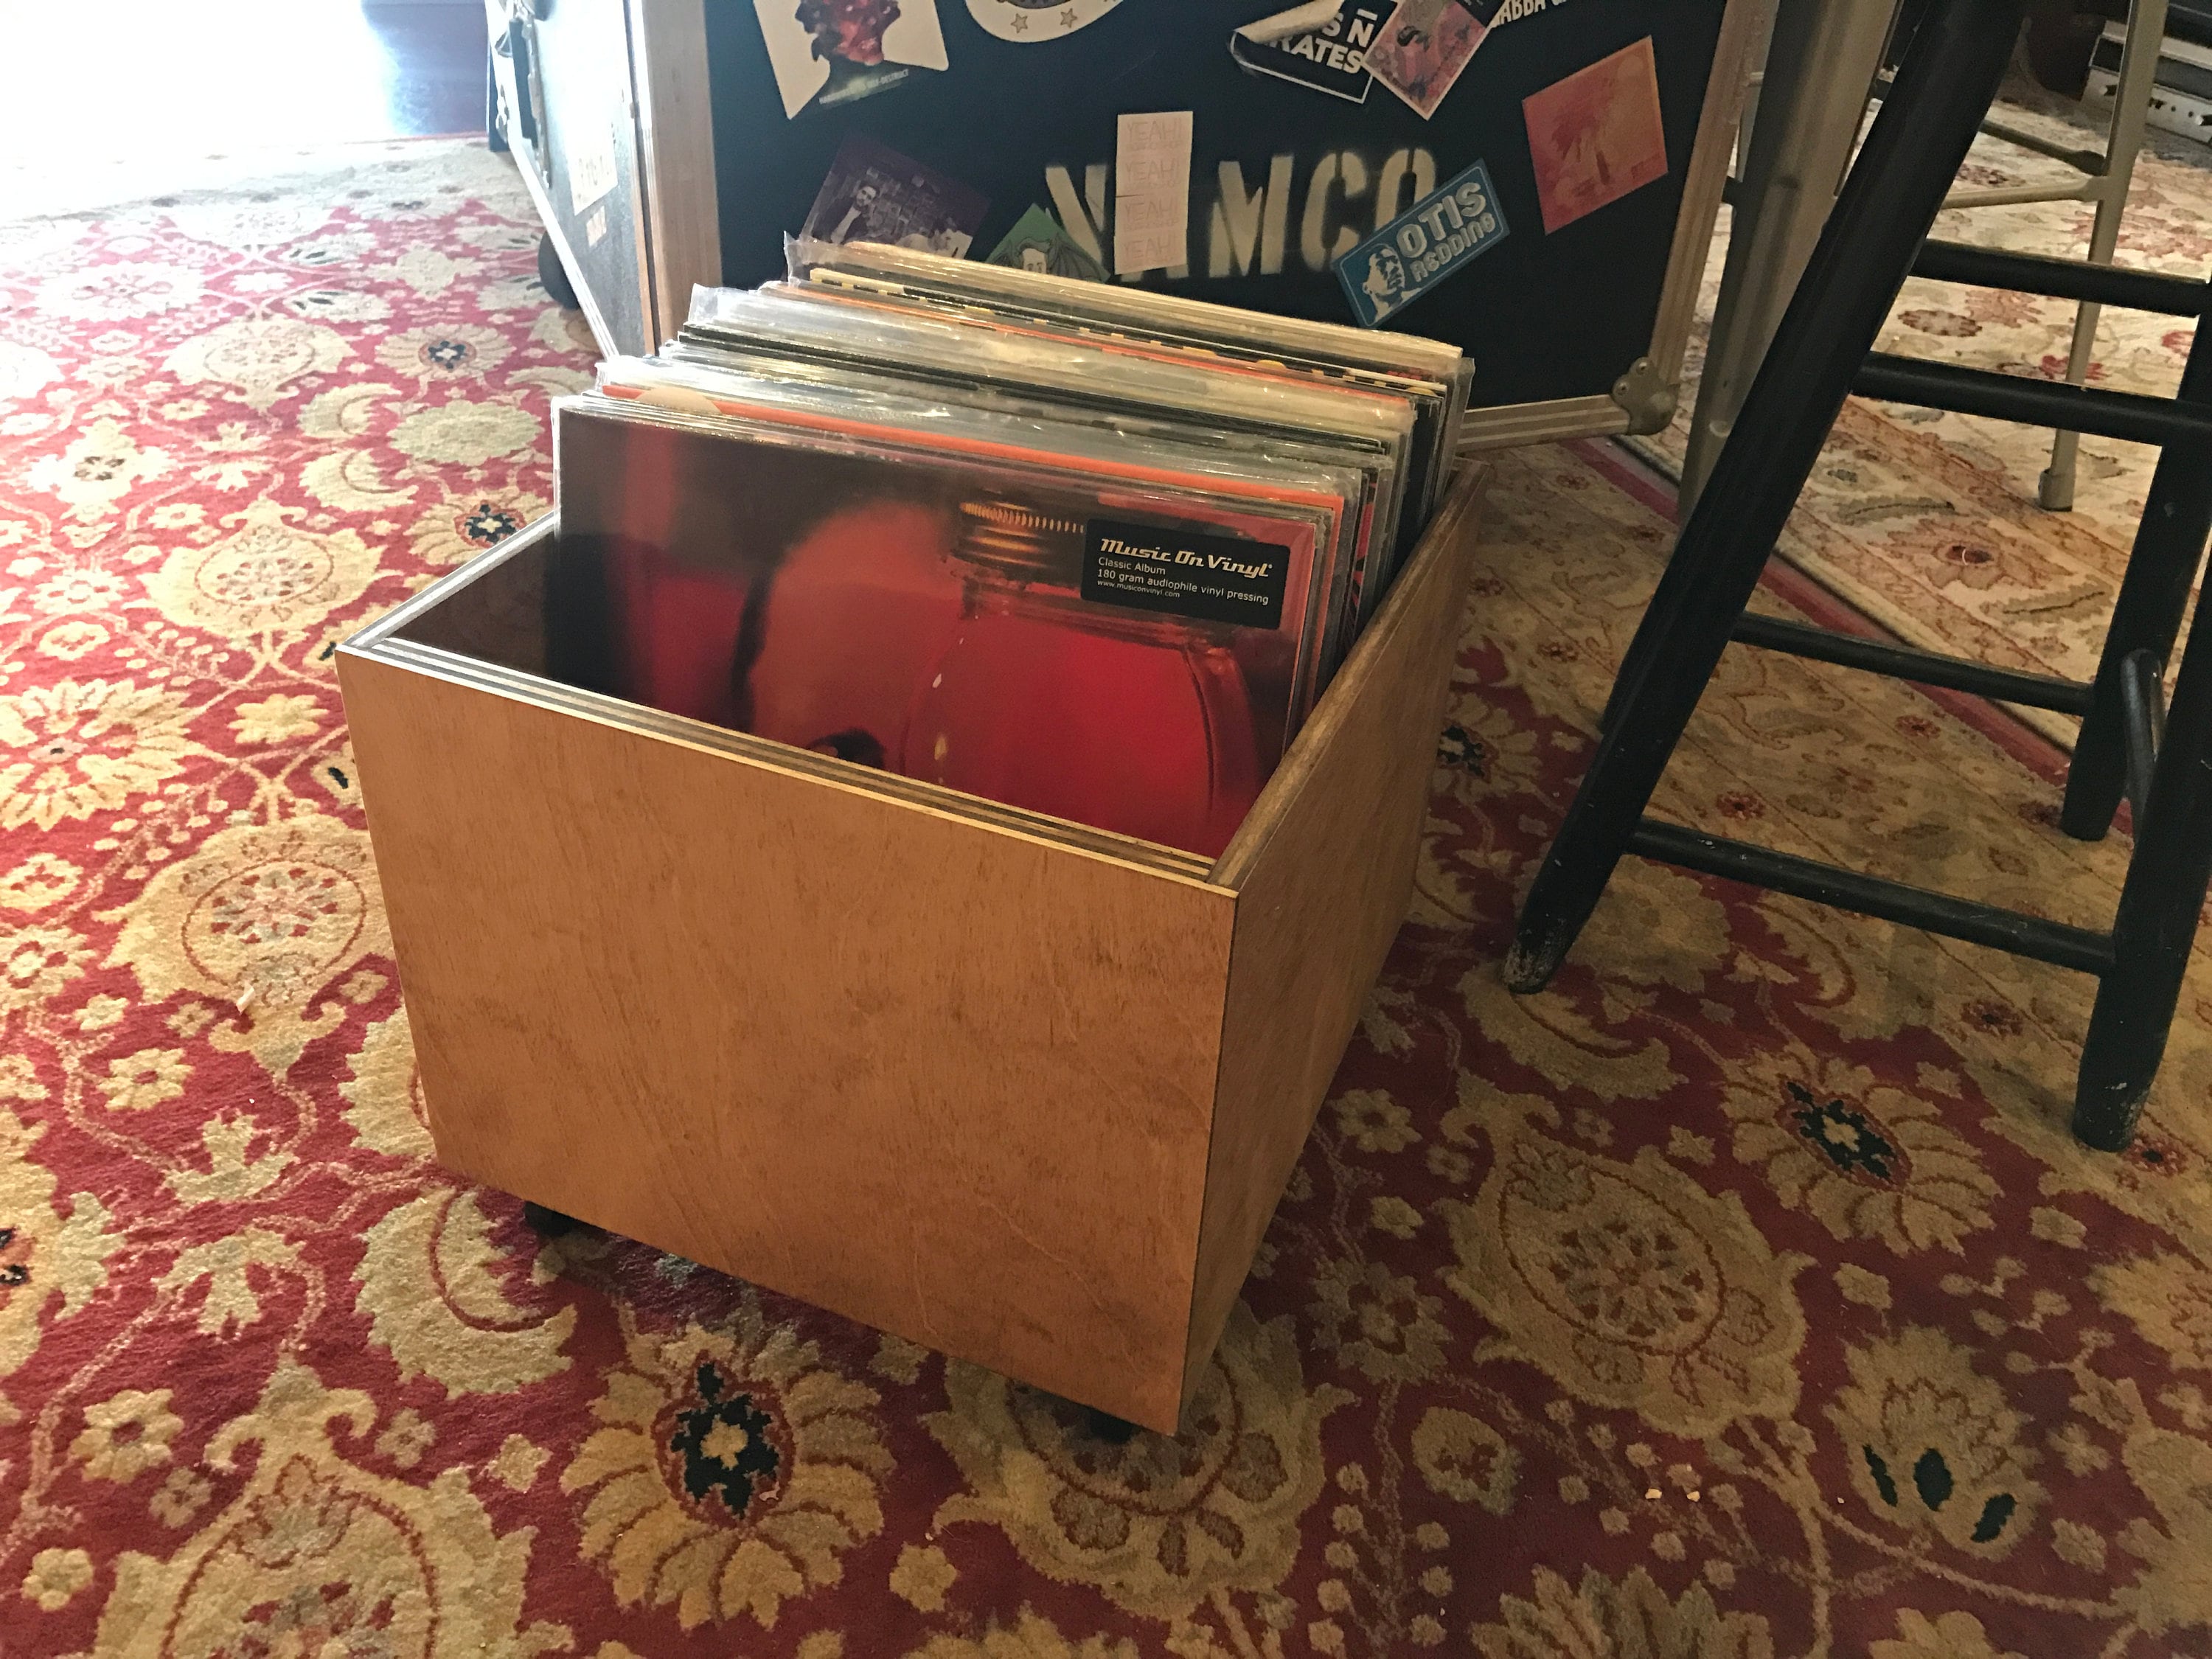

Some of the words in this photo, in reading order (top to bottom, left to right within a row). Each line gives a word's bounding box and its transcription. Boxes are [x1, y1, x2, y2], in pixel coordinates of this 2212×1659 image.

[1126, 118, 1181, 142] YEAH!
[1125, 158, 1180, 182] YEAH!
[1396, 181, 1486, 258] OTIS
[1098, 557, 1132, 570] Classic
[1135, 563, 1166, 575] Album
[1100, 538, 1171, 562] Music
[1175, 550, 1204, 567] On
[1208, 554, 1269, 579] Vinyl
[1097, 568, 1116, 580] 180
[1119, 574, 1144, 584] gram
[1147, 577, 1197, 592] audiophile
[1201, 586, 1224, 597] vinyl
[1226, 591, 1269, 605] pressing
[1097, 580, 1180, 597] www.musiconvinyl.com
